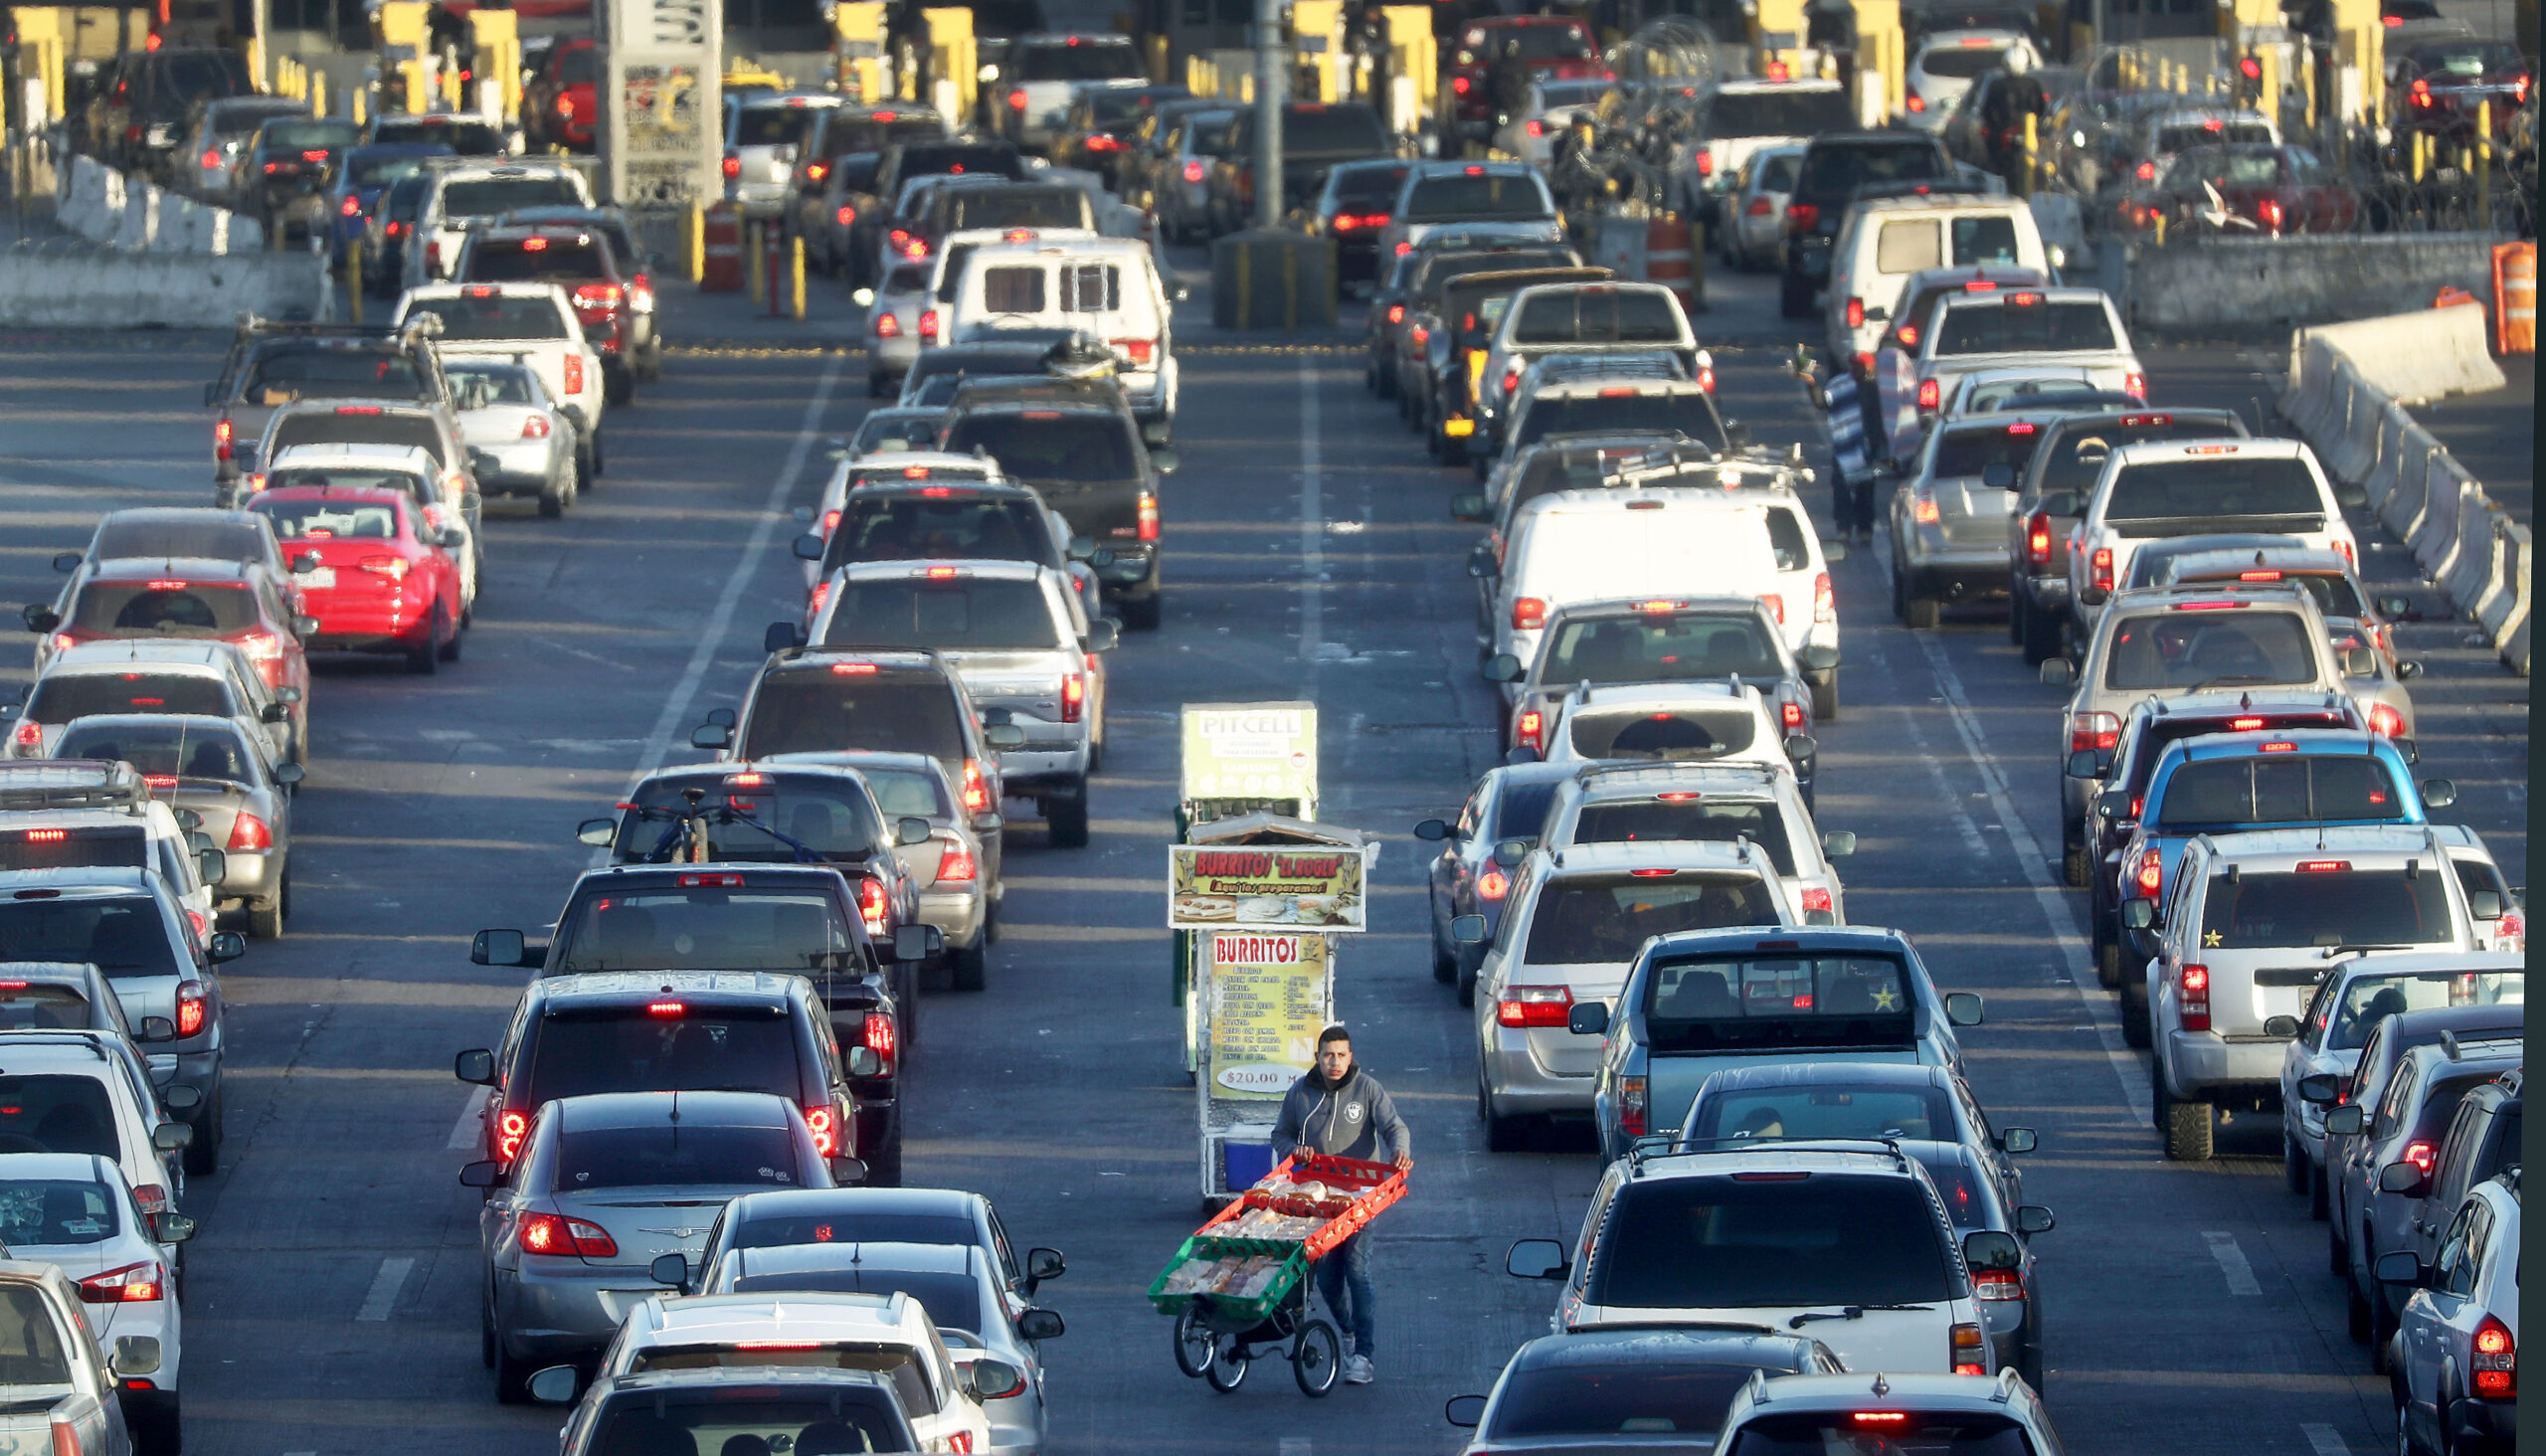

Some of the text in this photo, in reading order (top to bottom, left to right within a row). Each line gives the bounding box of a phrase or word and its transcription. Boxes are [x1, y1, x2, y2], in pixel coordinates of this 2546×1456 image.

[1203, 716, 1298, 734] PITCELL
[1194, 851, 1273, 878] BURRITOS
[1216, 938, 1297, 964] BURRITOS
[1227, 1071, 1278, 1083] $20.00
